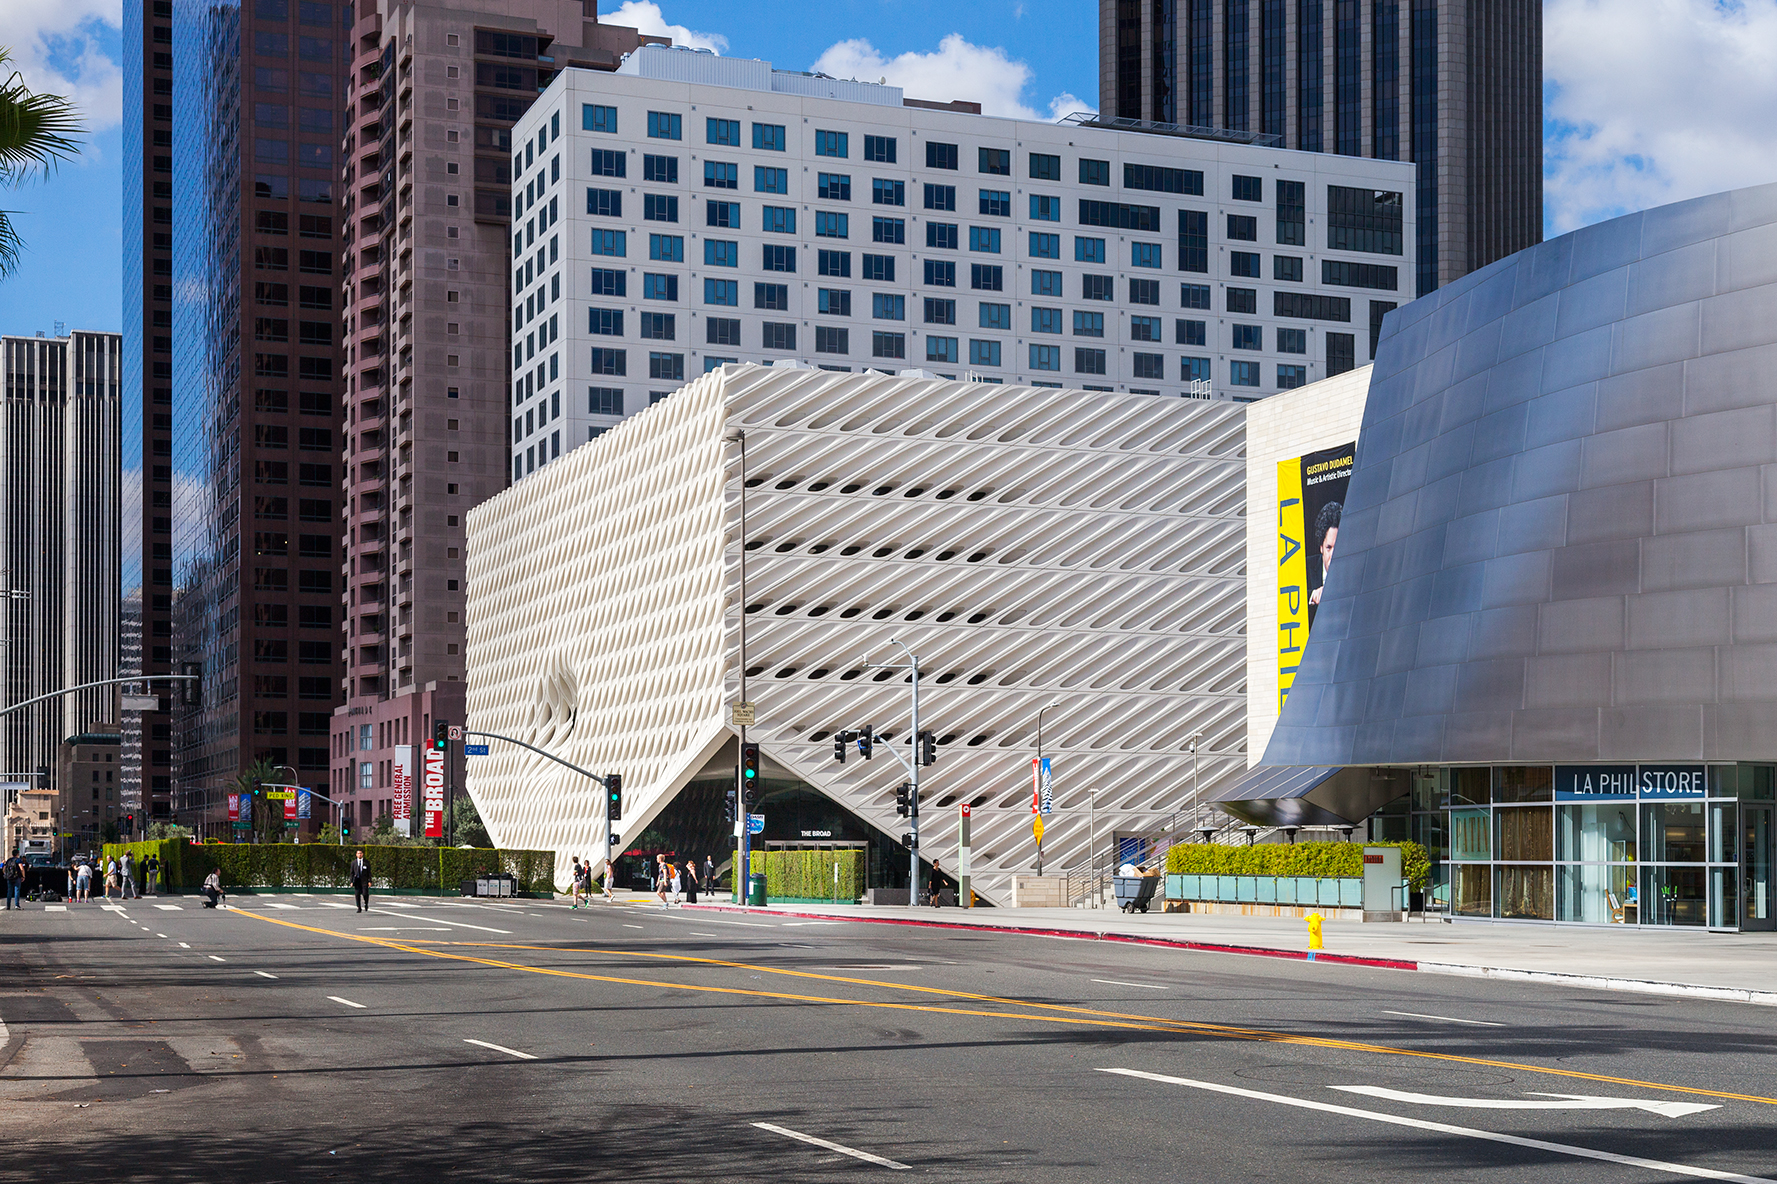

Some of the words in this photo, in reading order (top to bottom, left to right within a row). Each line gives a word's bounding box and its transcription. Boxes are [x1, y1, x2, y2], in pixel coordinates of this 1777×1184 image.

[1306, 461, 1329, 476] GUSTAVO
[1329, 455, 1353, 470] DUDAMEL
[1306, 476, 1319, 486] Music
[1323, 471, 1337, 481] Artistic
[1279, 498, 1301, 567] LA
[394, 764, 403, 800] GENERAL
[426, 748, 444, 811] BROAD
[1573, 773, 1594, 795] LA
[1600, 773, 1636, 795] PHIL
[1642, 771, 1703, 793] STORE
[403, 775, 411, 820] ADMISSION
[394, 801, 402, 820] FREE
[425, 812, 434, 829] THE
